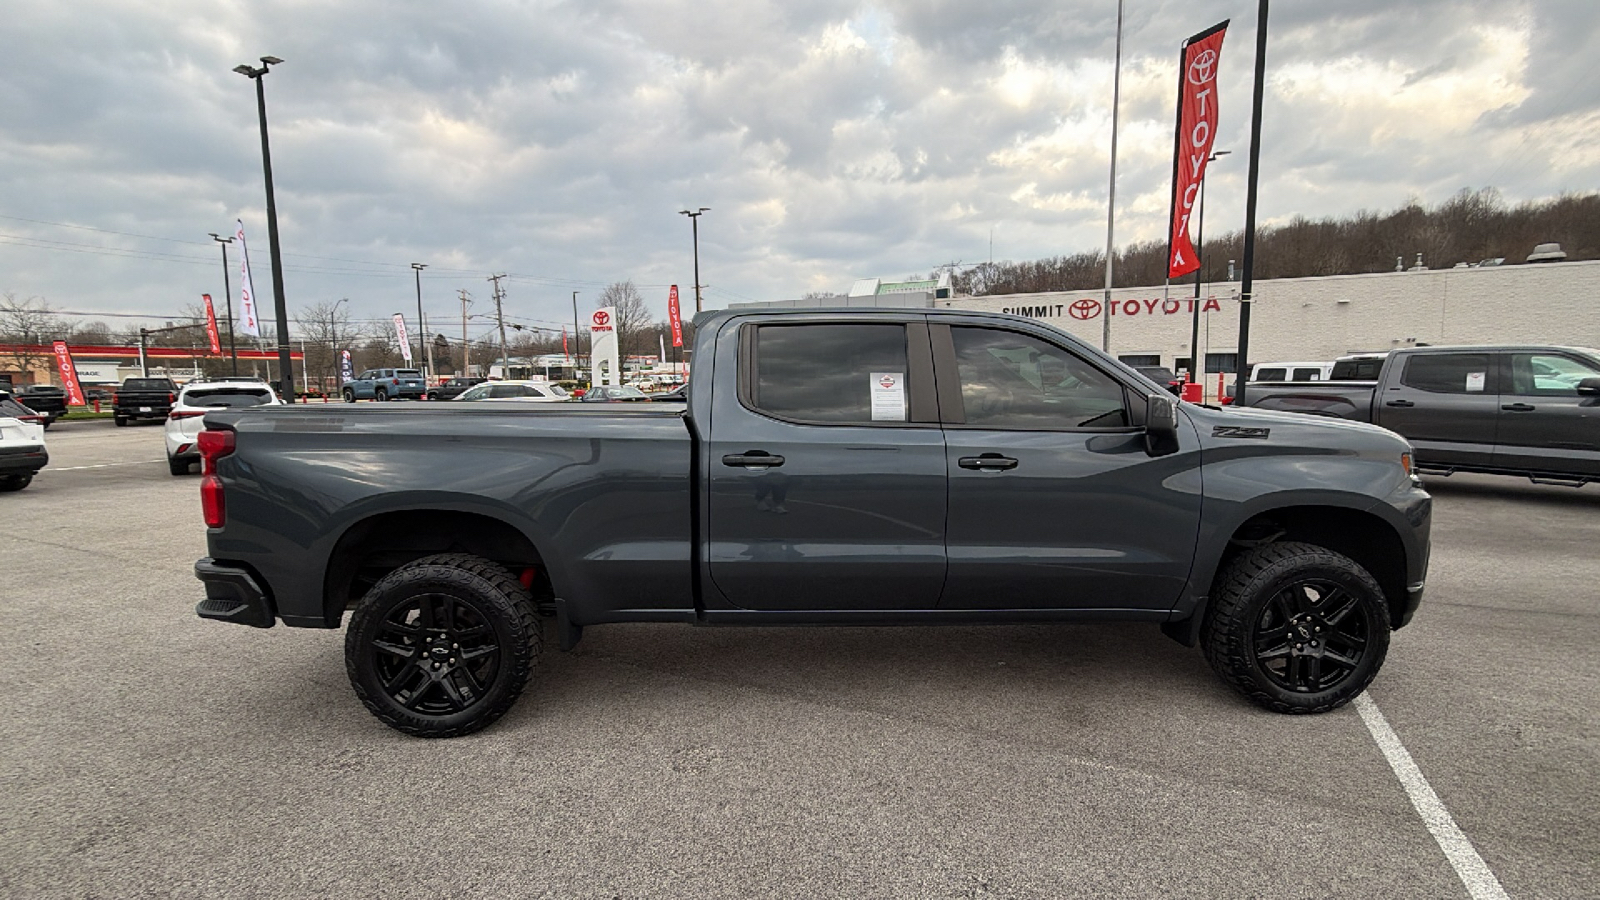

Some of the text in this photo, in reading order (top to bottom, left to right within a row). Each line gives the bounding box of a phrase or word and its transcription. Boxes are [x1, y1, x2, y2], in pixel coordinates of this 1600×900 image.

[670, 299, 683, 344] TOYOTA
[1002, 295, 1222, 318] SUMMIT TOYOTA
[60, 355, 81, 404] TOYOTA
